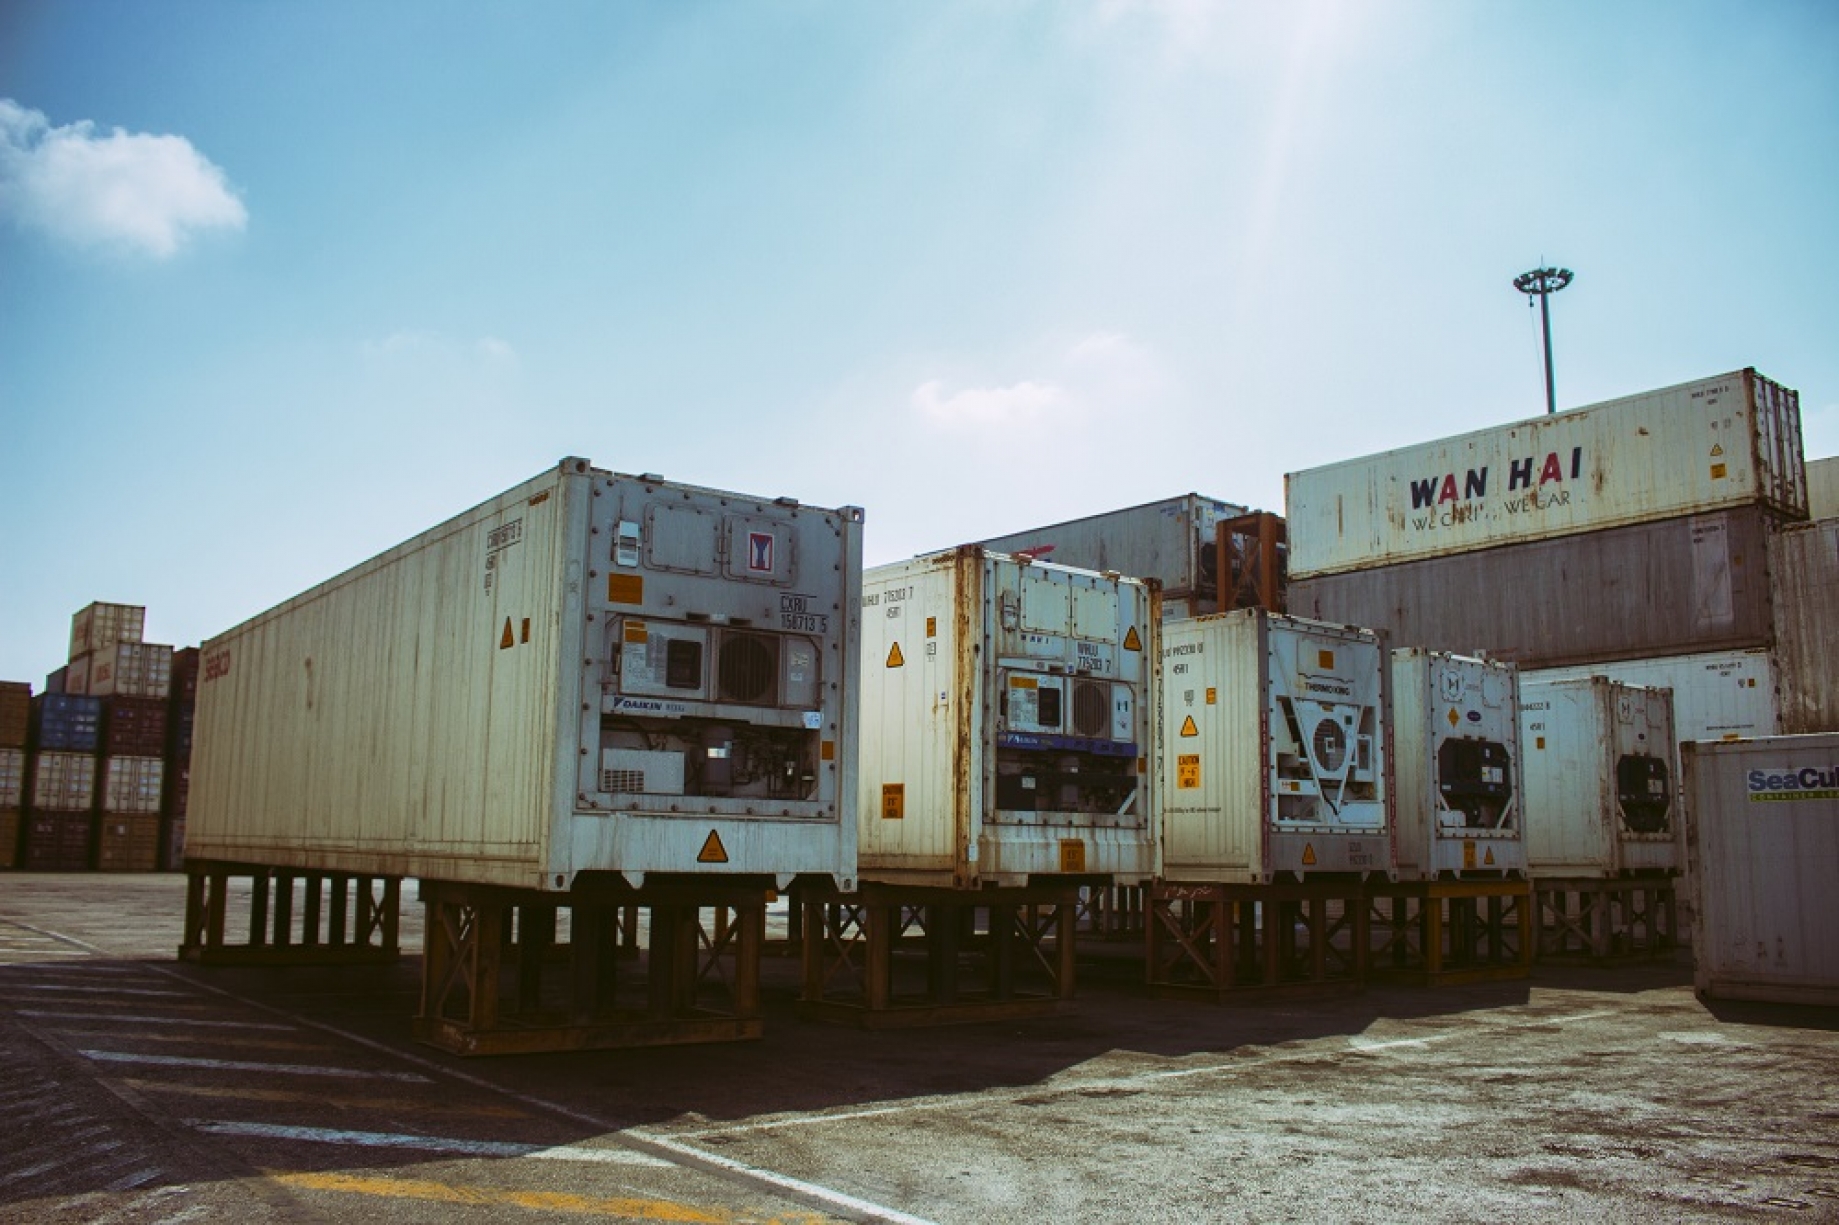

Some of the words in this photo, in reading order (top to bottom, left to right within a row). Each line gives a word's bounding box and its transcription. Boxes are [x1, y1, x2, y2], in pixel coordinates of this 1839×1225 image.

[1410, 466, 1488, 510] WAN
[1508, 446, 1582, 491] HAI
[820, 616, 828, 634] 5
[623, 700, 663, 711] DAIKIN
